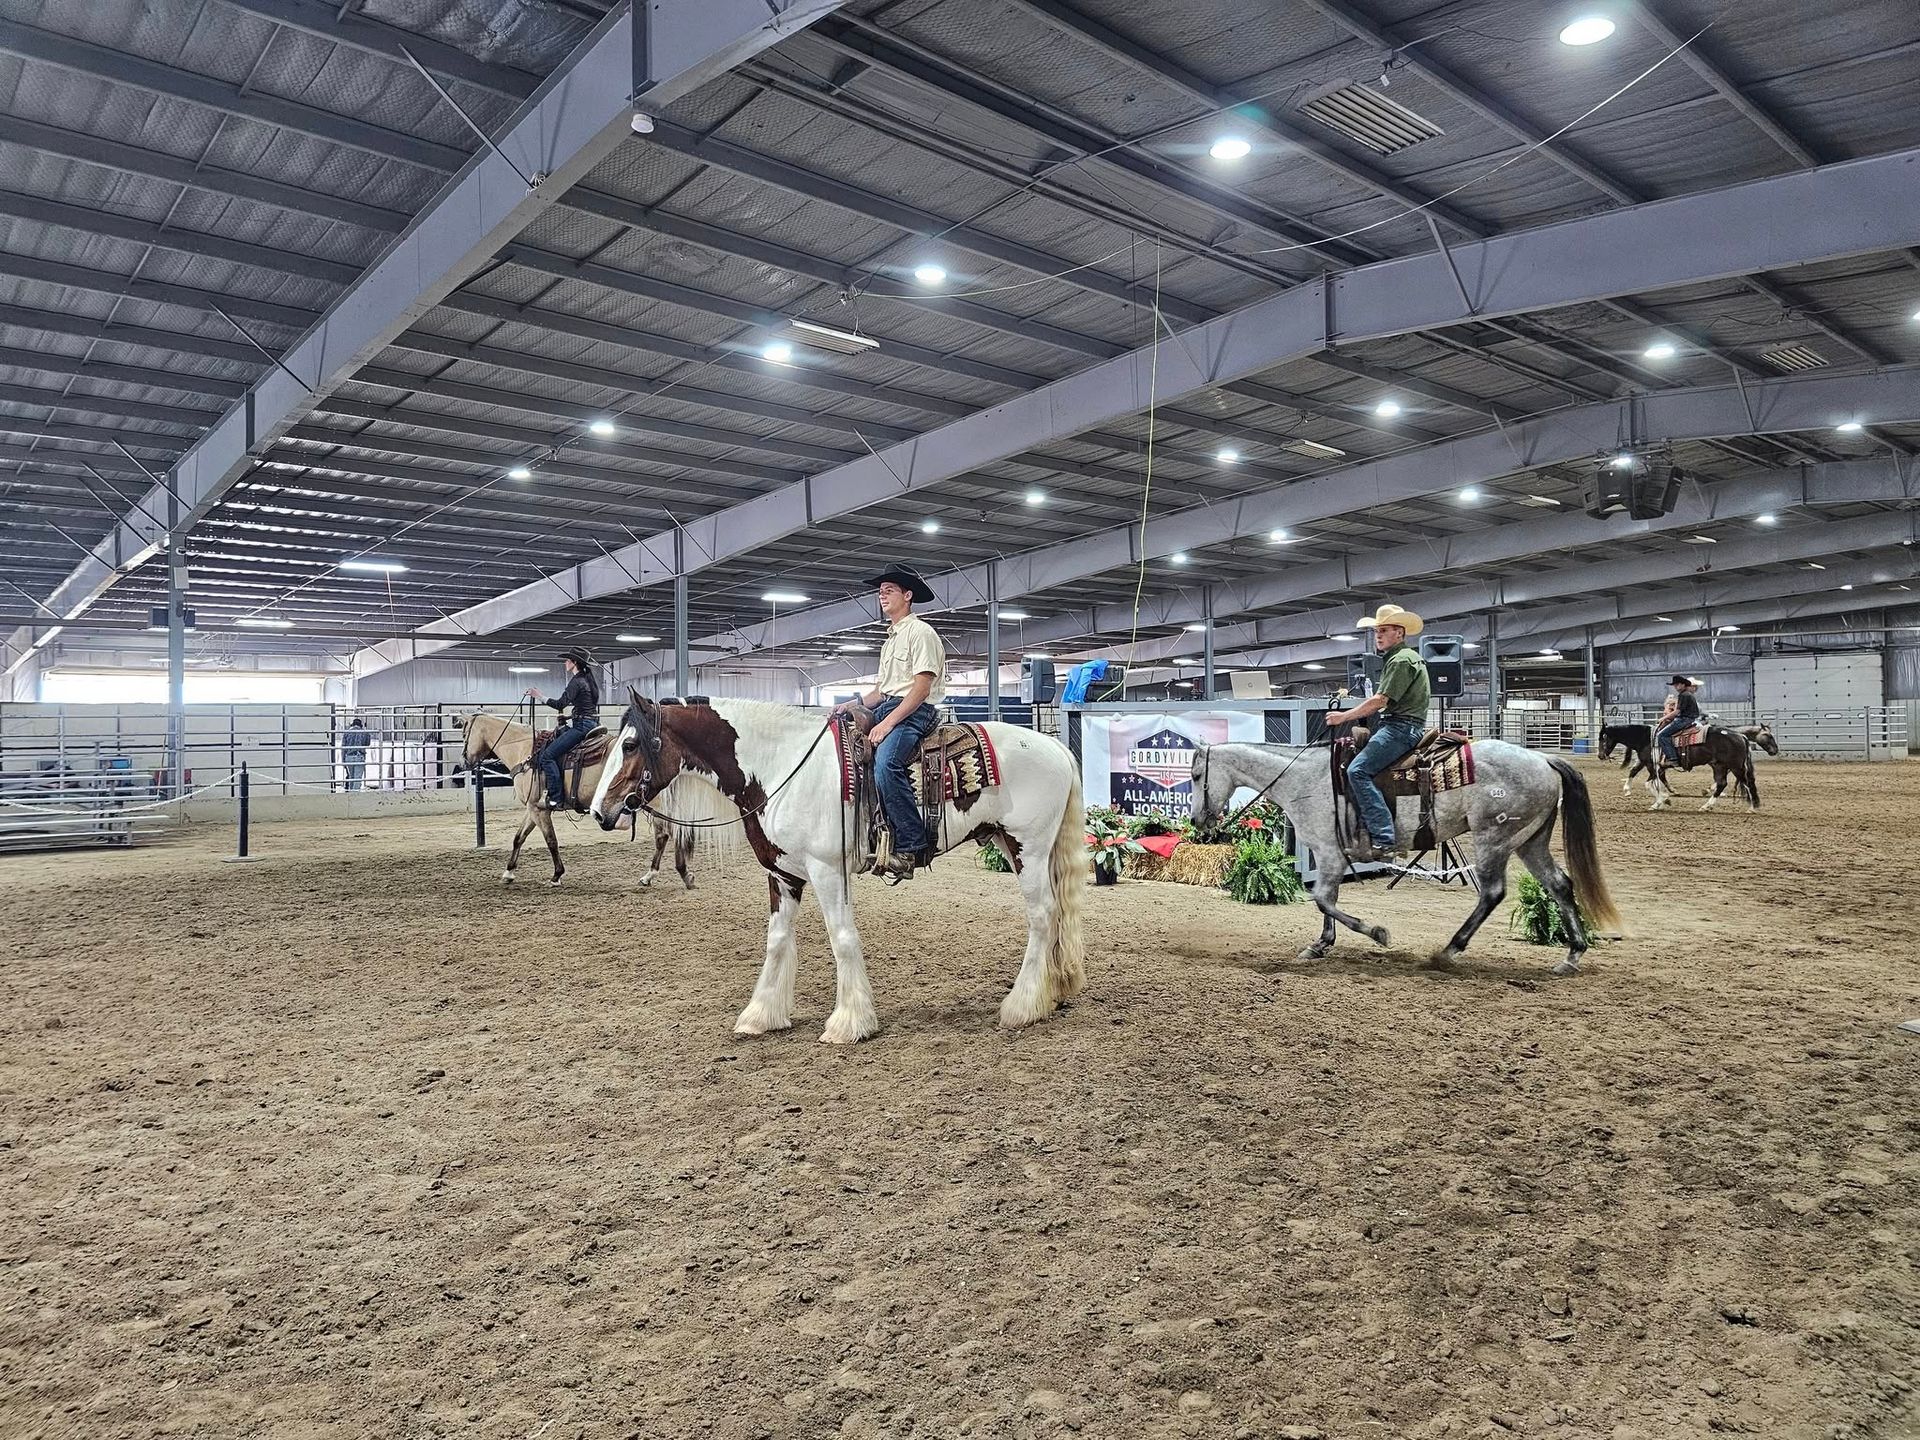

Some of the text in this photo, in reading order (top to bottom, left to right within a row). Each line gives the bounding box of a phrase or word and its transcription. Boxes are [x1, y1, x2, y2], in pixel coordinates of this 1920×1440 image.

[1131, 751, 1190, 764] GORDYVIL
[1160, 771, 1175, 782] USA
[1123, 789, 1192, 805] ALL-AMERIC
[1173, 805, 1192, 819] SA
